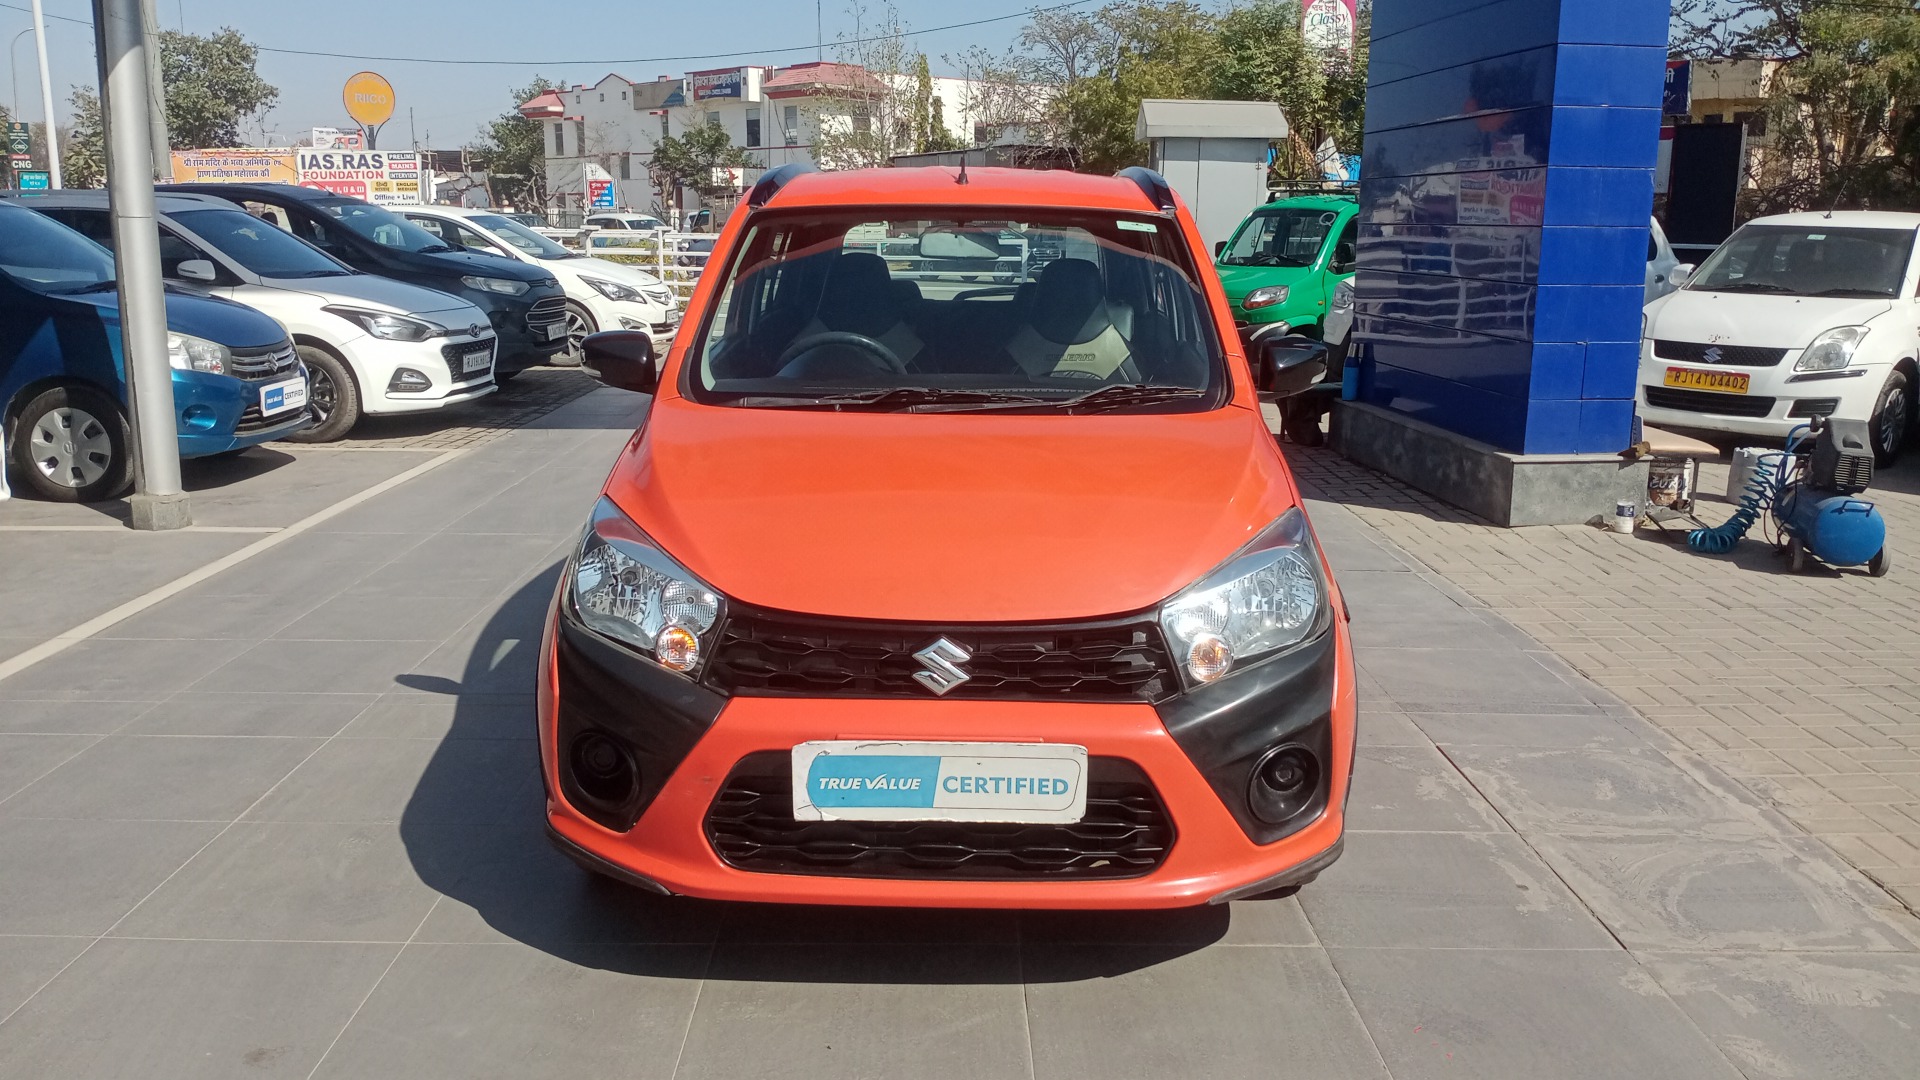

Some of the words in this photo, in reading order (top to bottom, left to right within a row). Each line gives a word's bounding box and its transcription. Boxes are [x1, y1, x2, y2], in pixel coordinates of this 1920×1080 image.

[1311, 13, 1346, 27] Classy
[354, 92, 387, 105] RIICO
[12, 160, 33, 169] CNG
[300, 154, 335, 170] IAS
[342, 153, 384, 170] RAS
[260, 168, 270, 177] की
[303, 170, 384, 180] FOUNDATION
[1673, 371, 1747, 390] RJ14TD4402
[284, 389, 304, 400] CERTIFIED
[818, 777, 862, 790] TRUE
[864, 773, 922, 791] VALUE
[942, 775, 1069, 795] CERTIFIED
